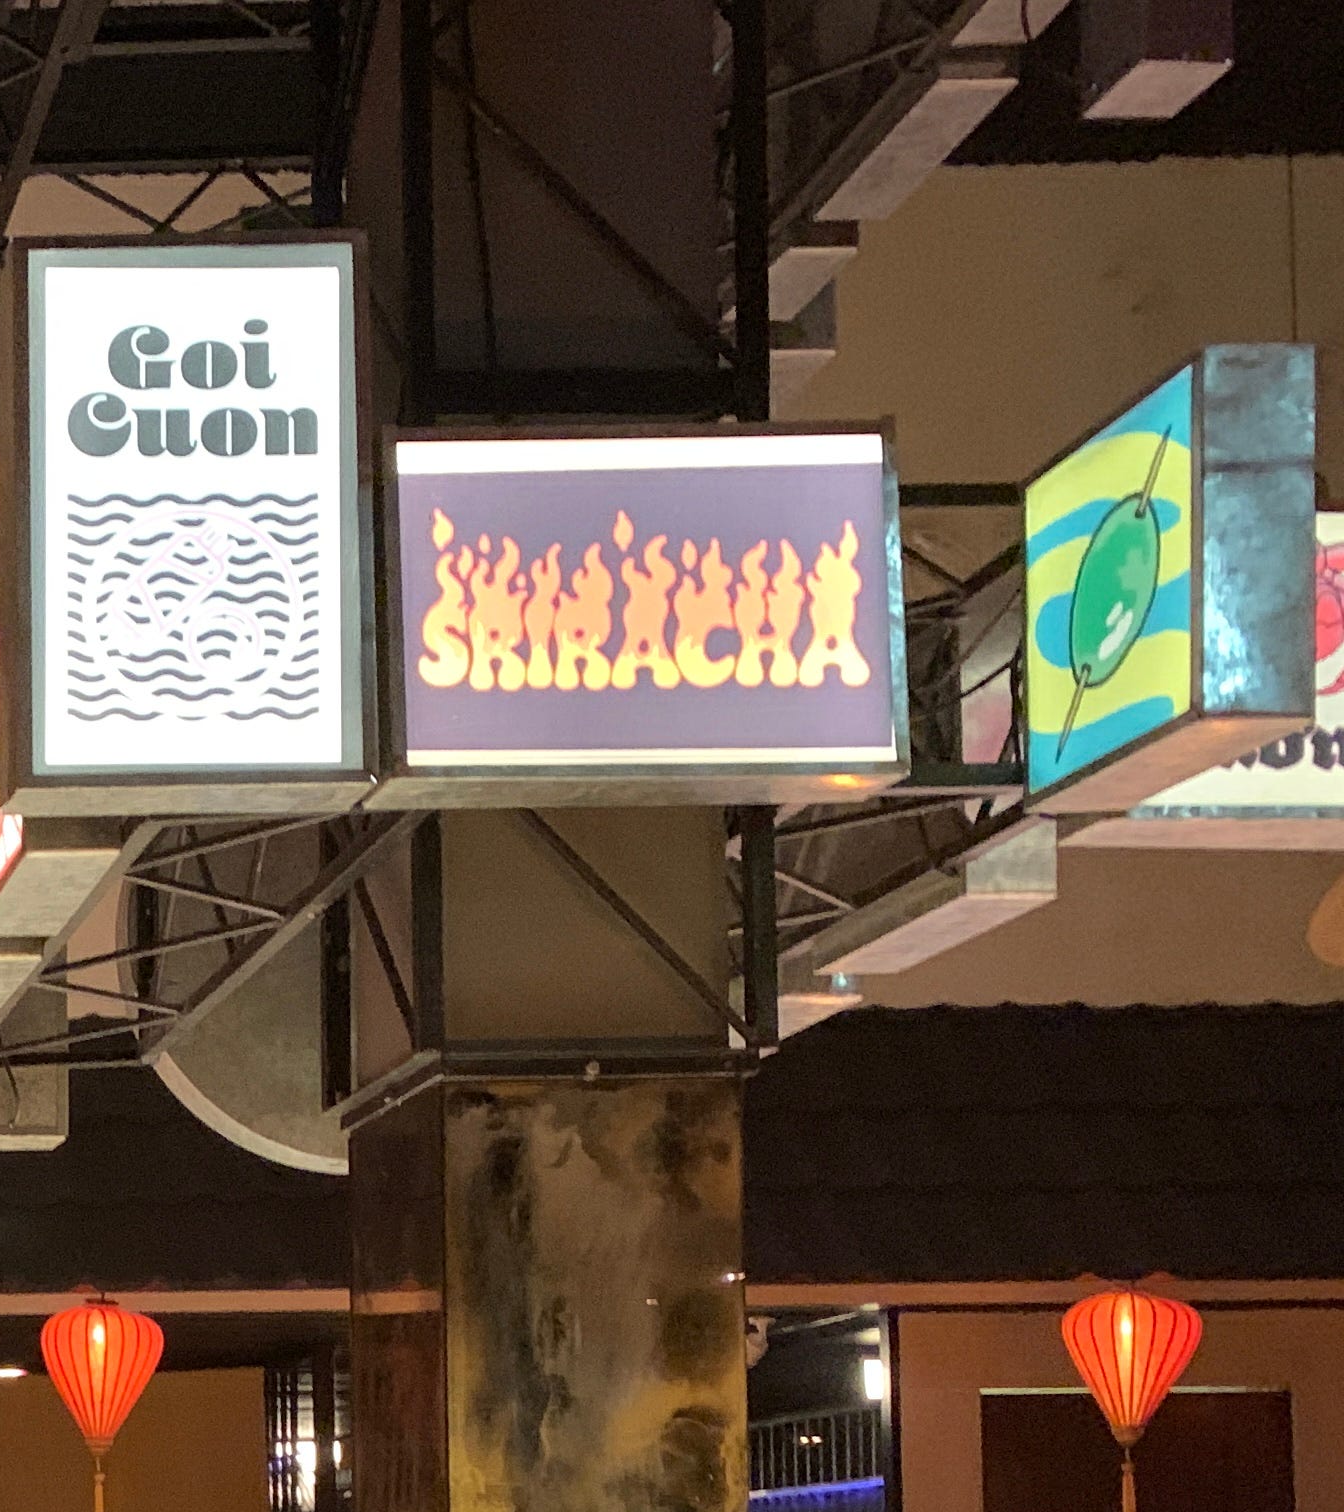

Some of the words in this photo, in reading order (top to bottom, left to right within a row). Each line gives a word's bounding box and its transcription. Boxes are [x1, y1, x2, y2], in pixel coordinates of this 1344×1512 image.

[108, 318, 277, 390] Goi
[67, 392, 319, 457] Cuon
[418, 507, 871, 691] SRIRACHA
